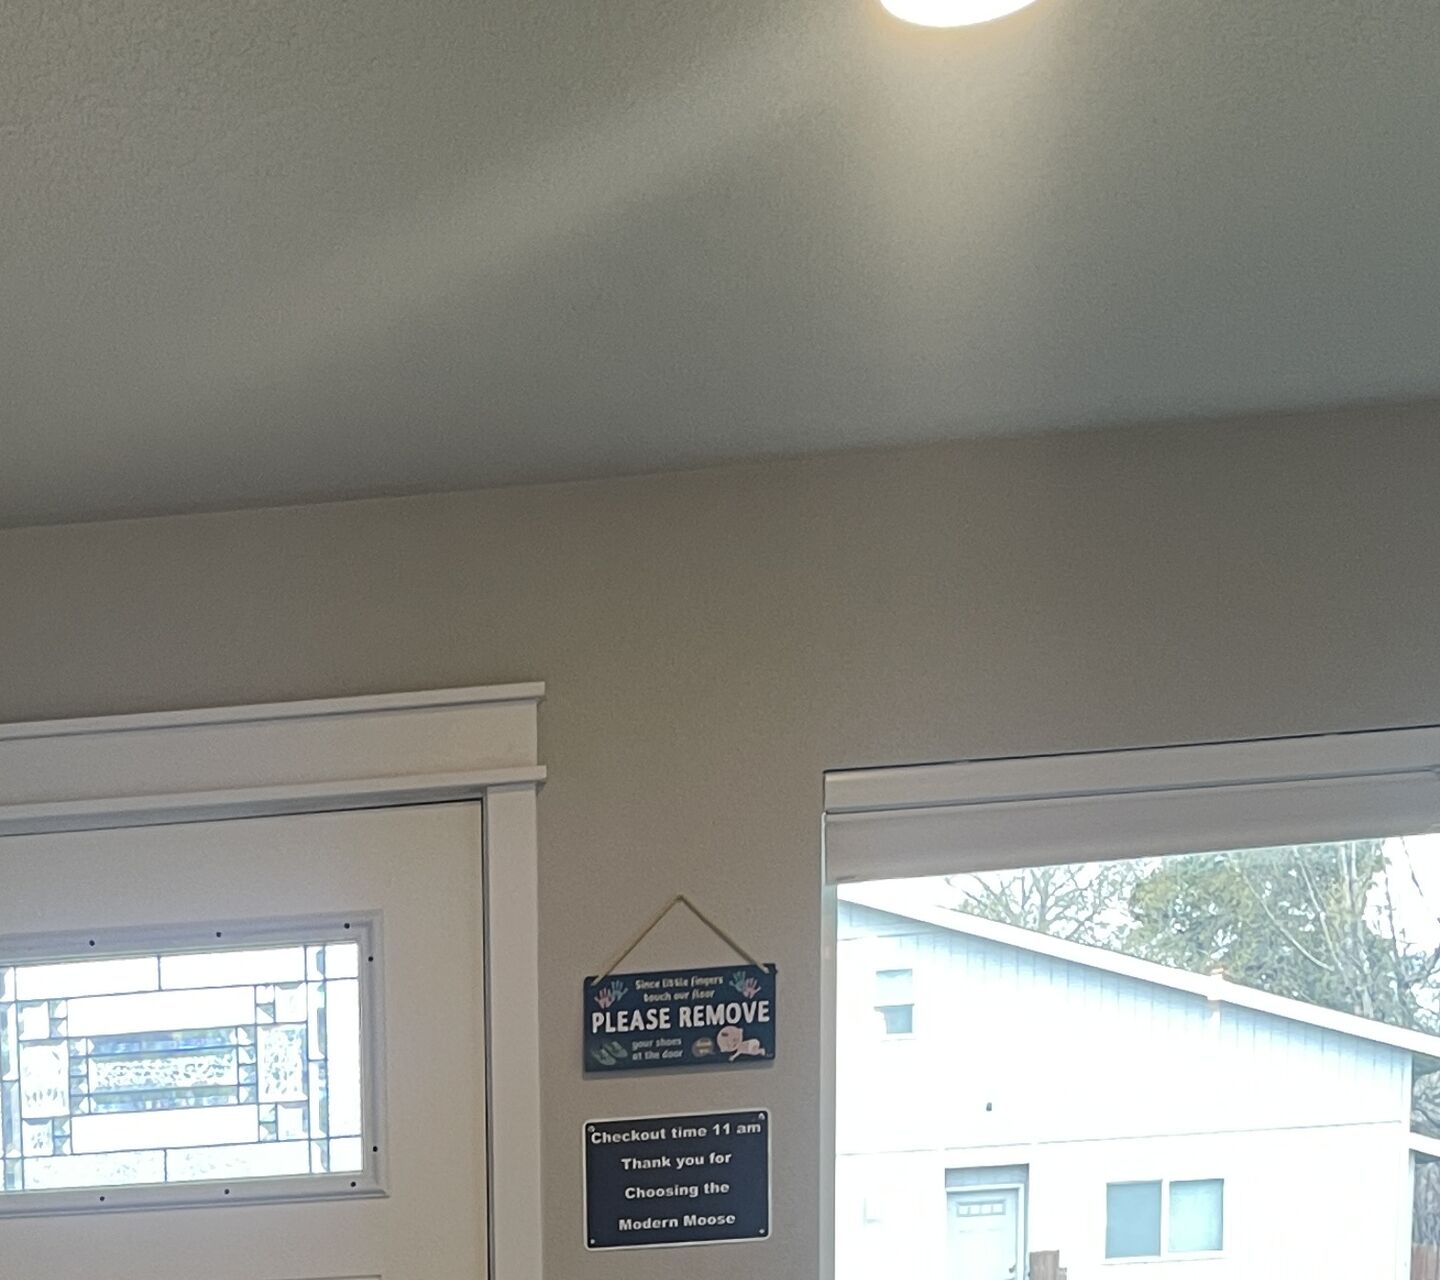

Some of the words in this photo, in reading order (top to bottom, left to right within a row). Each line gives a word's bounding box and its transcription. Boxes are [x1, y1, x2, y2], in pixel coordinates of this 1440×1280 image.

[635, 979, 660, 990] Since
[690, 976, 723, 987] fingers
[592, 1008, 671, 1034] PLEASE
[679, 1000, 770, 1028] REMOVE
[632, 1039, 653, 1051] your
[591, 1129, 666, 1144] Checkout
[671, 1125, 707, 1139] time
[712, 1123, 731, 1135] 11
[736, 1123, 761, 1134] am
[621, 1156, 671, 1170] Thank
[676, 1154, 704, 1169] you
[709, 1152, 732, 1164] for
[625, 1185, 699, 1199] Choosing
[704, 1182, 730, 1194] the
[618, 1217, 678, 1231] Modern
[683, 1214, 736, 1226] Moose
